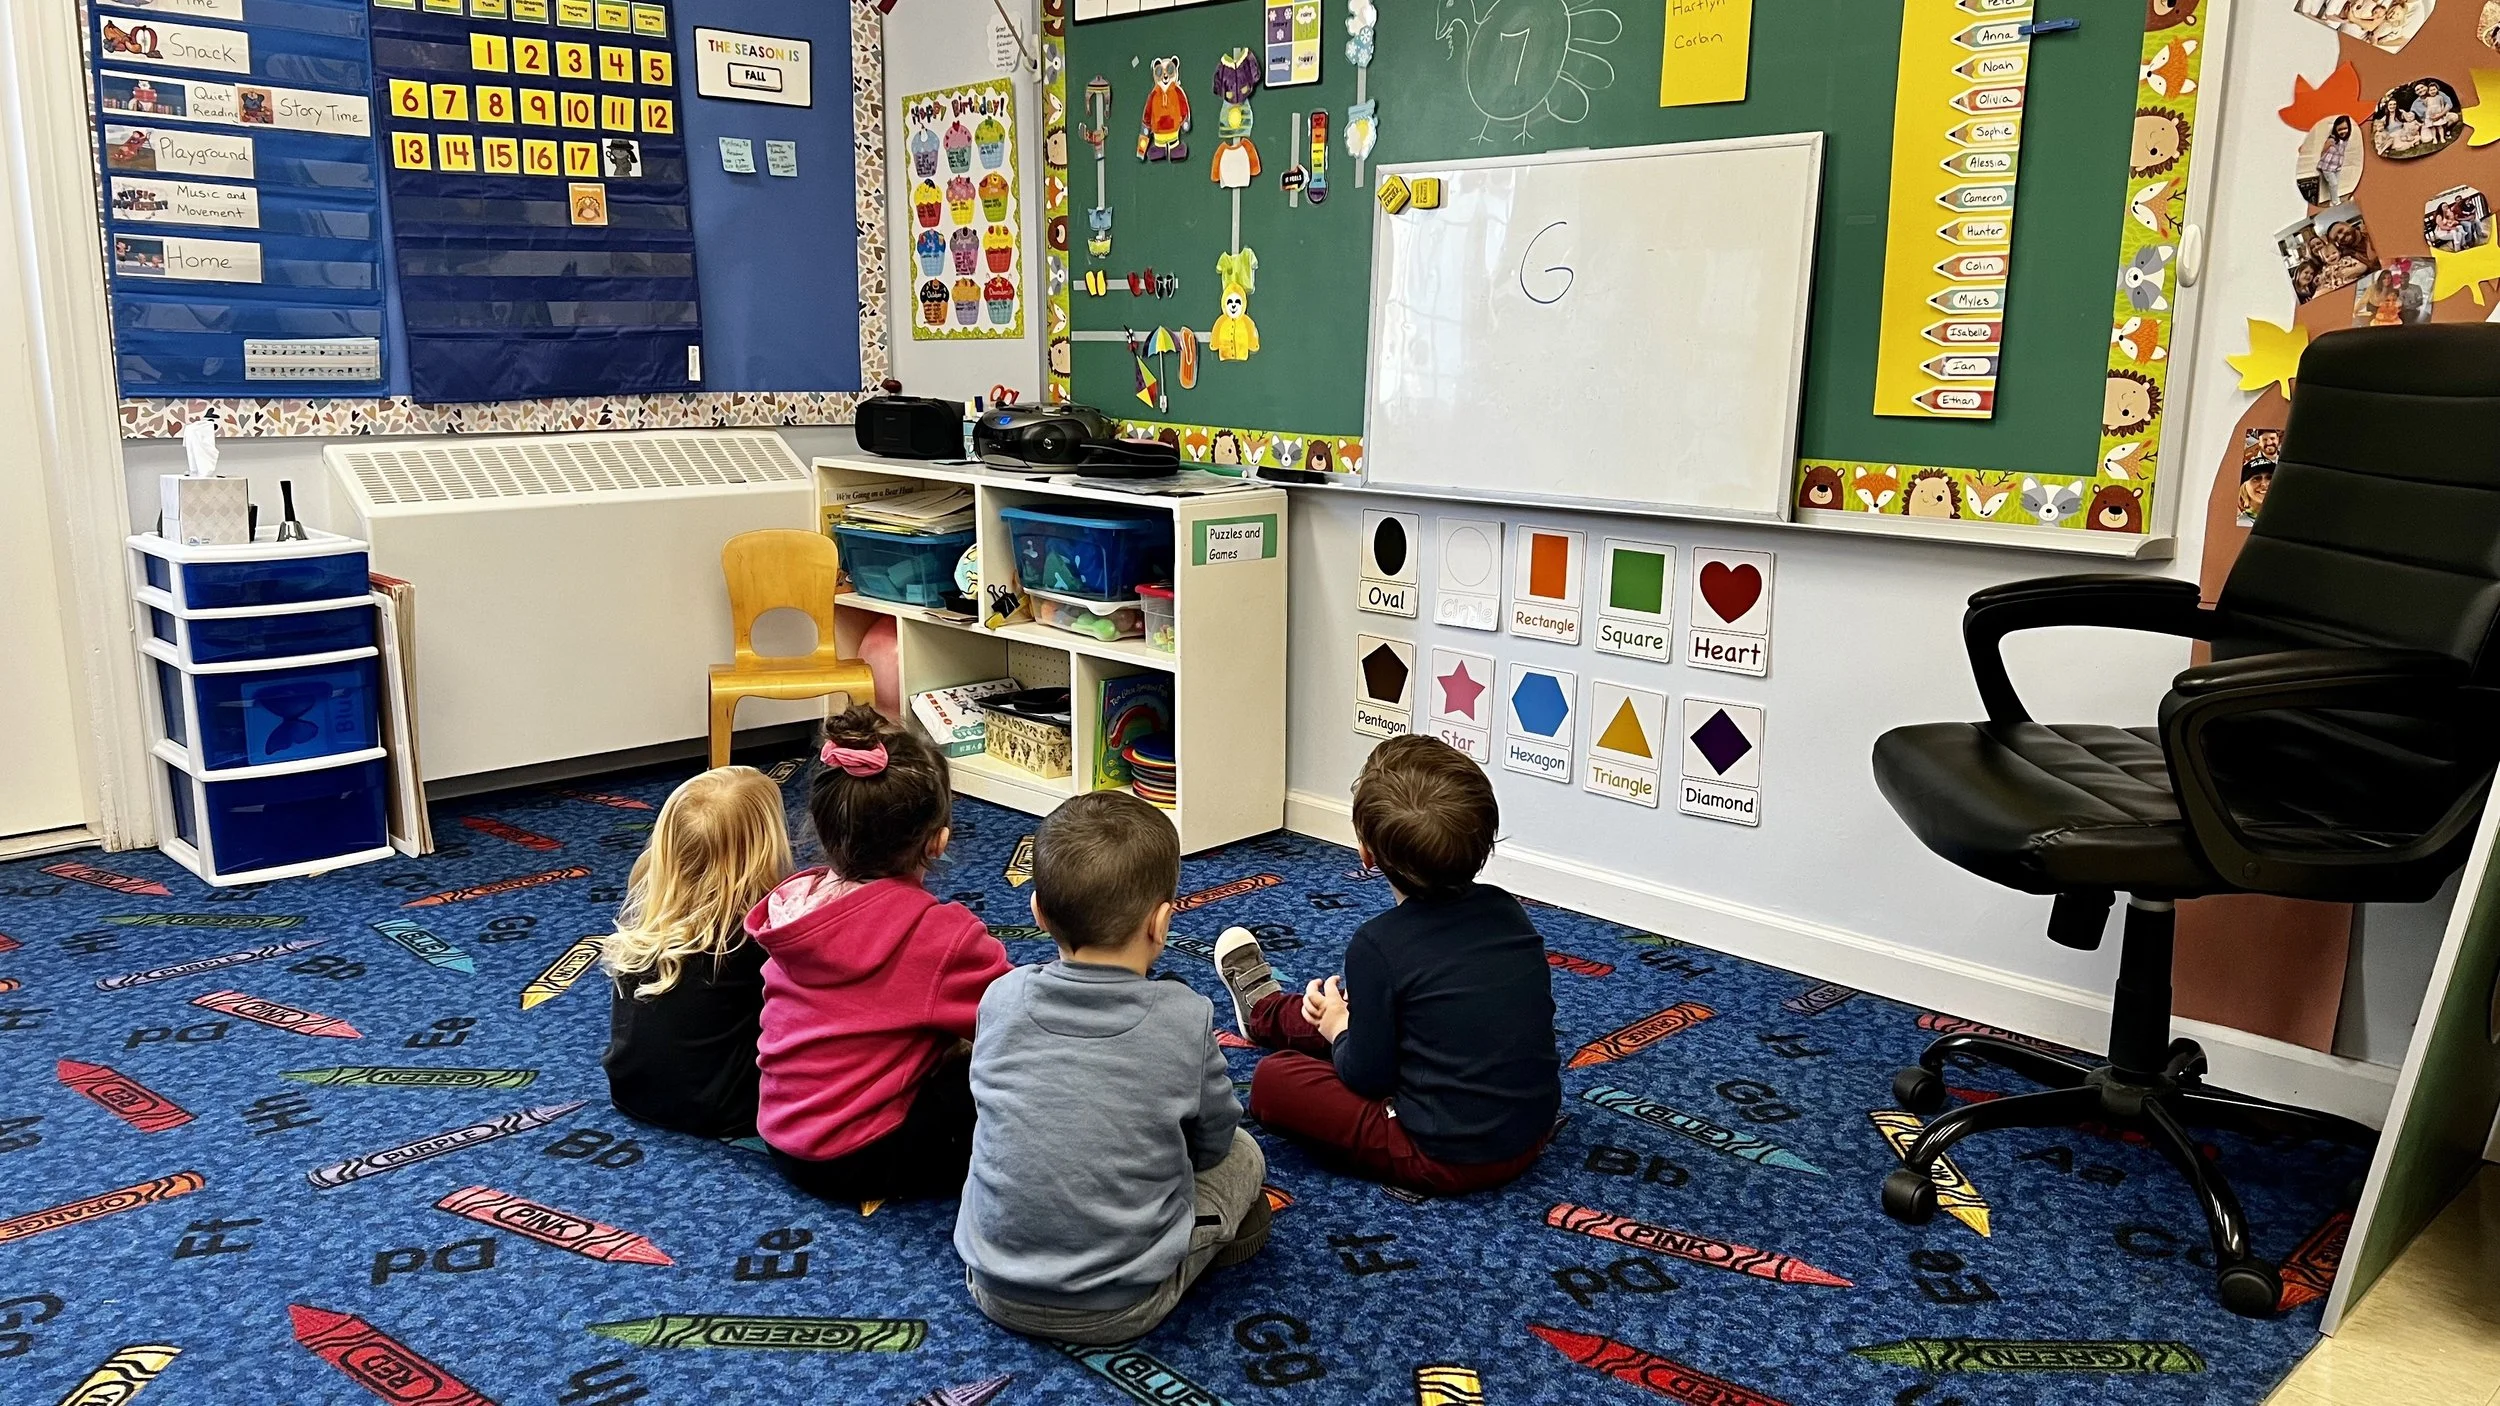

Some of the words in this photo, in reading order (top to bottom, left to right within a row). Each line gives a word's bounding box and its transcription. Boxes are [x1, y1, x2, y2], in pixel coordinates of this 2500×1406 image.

[1981, 29, 2014, 41] Anna
[169, 32, 237, 64] Snack
[486, 40, 494, 65] 1
[524, 44, 540, 70] 2
[568, 48, 583, 73] 3
[708, 39, 731, 54] THE
[735, 43, 785, 61] SEASON
[788, 50, 800, 62] IS
[1500, 28, 1532, 86] 7
[609, 52, 624, 77] 4
[650, 58, 665, 81] 5
[745, 70, 767, 82] FALL
[1982, 61, 2014, 73] Noah
[194, 86, 232, 101] Quiet
[279, 98, 323, 125] Story
[326, 105, 363, 123] Time
[402, 87, 419, 112] 6
[442, 89, 457, 114] 7
[489, 93, 504, 117] 8
[530, 95, 546, 120] 9
[567, 98, 589, 123] 10
[951, 94, 1005, 118] Birthday!
[1979, 93, 2013, 105] Olivia
[611, 102, 624, 126] 11
[649, 104, 668, 129] 12
[1976, 126, 2012, 140] Sophie
[159, 137, 249, 164] Playground
[401, 138, 424, 164] 13
[446, 141, 469, 166] 14
[489, 143, 513, 169] 15
[530, 146, 552, 170] 16
[571, 147, 591, 171] 17
[1969, 157, 2007, 169] Alessia
[117, 190, 156, 202] MUSIC
[177, 185, 220, 199] Music
[227, 191, 247, 200] and
[1963, 192, 2004, 204] Cameron
[177, 204, 245, 219] Movement
[1967, 227, 2003, 237] Hunter
[167, 244, 232, 269] Home
[1519, 221, 1575, 305] G
[1965, 261, 1994, 272] Colin
[1959, 295, 1990, 308] Myles
[1950, 327, 1989, 338] Isabelle
[1952, 361, 1976, 371] Ian
[1942, 394, 1975, 406] Ethan
[836, 492, 851, 501] We're
[852, 490, 870, 500] Going
[885, 487, 898, 496] Bear
[899, 485, 914, 495] Hunt
[827, 513, 841, 521] What
[1209, 527, 1242, 540] Puzzles
[1244, 527, 1261, 538] and
[1209, 548, 1238, 560] Games
[1368, 586, 1406, 611] Oval
[1514, 610, 1575, 634] Rectangle
[1600, 624, 1664, 651] Square
[1694, 637, 1761, 666] Heart
[1356, 710, 1407, 735] Pentagon
[1440, 730, 1476, 753] Star
[1510, 745, 1566, 772] Hexagon
[1592, 766, 1653, 796] Triangle
[1685, 787, 1754, 815] Diamond
[403, 931, 447, 953] BLUE
[159, 955, 239, 976] PURPLE
[287, 955, 367, 980] Bb
[249, 1003, 293, 1024] PINK
[405, 1017, 477, 1048] Ee
[1620, 1018, 1678, 1044] ORANGE
[380, 1071, 481, 1085] GREEN
[101, 1087, 146, 1108] RED
[1716, 1079, 1802, 1124] Gg
[1646, 1106, 1725, 1142] BLUE
[385, 1127, 479, 1164] PURPLE
[543, 1128, 644, 1169] Bb
[1584, 1145, 1689, 1188] Bb
[5, 1199, 125, 1237] ORANGE
[513, 1207, 579, 1237] PINK
[172, 1218, 263, 1261] Ff
[1628, 1226, 1716, 1254] PINK
[733, 1228, 813, 1282] Ee
[1326, 1231, 1418, 1278] Ff
[719, 1324, 850, 1343] GREEN
[1232, 1311, 1328, 1388] Gg
[1991, 1347, 2126, 1367] GREEN
[361, 1352, 418, 1391] RED
